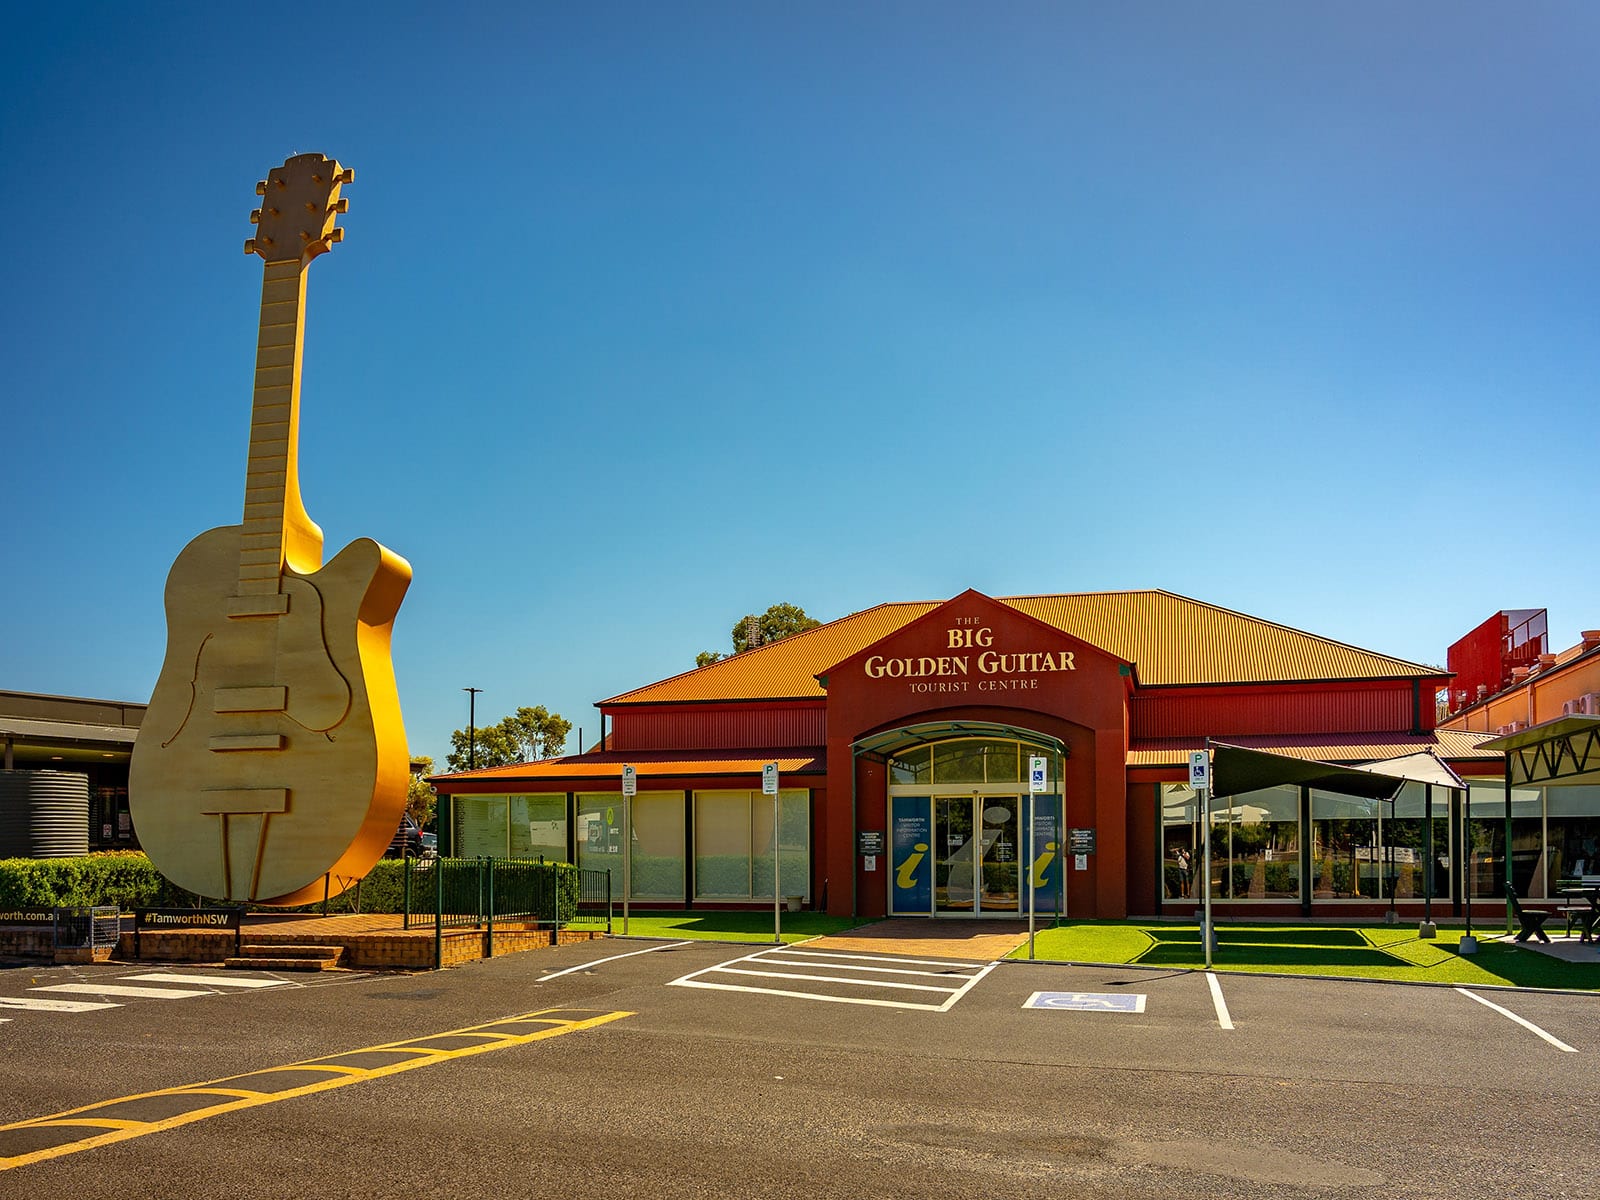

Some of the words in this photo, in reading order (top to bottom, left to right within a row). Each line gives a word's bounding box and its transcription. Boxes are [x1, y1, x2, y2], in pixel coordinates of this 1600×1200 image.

[956, 617, 980, 625] THE
[947, 628, 994, 649] BIG
[864, 656, 969, 678] GOLDEN
[978, 651, 1077, 674] GUITAR
[909, 682, 970, 693] TOURIST
[978, 679, 1038, 691] CENTRE
[1195, 754, 1203, 763] P
[1034, 760, 1042, 768] P
[626, 767, 632, 776] P
[766, 765, 773, 774] P
[144, 912, 228, 925] #TamworthNSW
